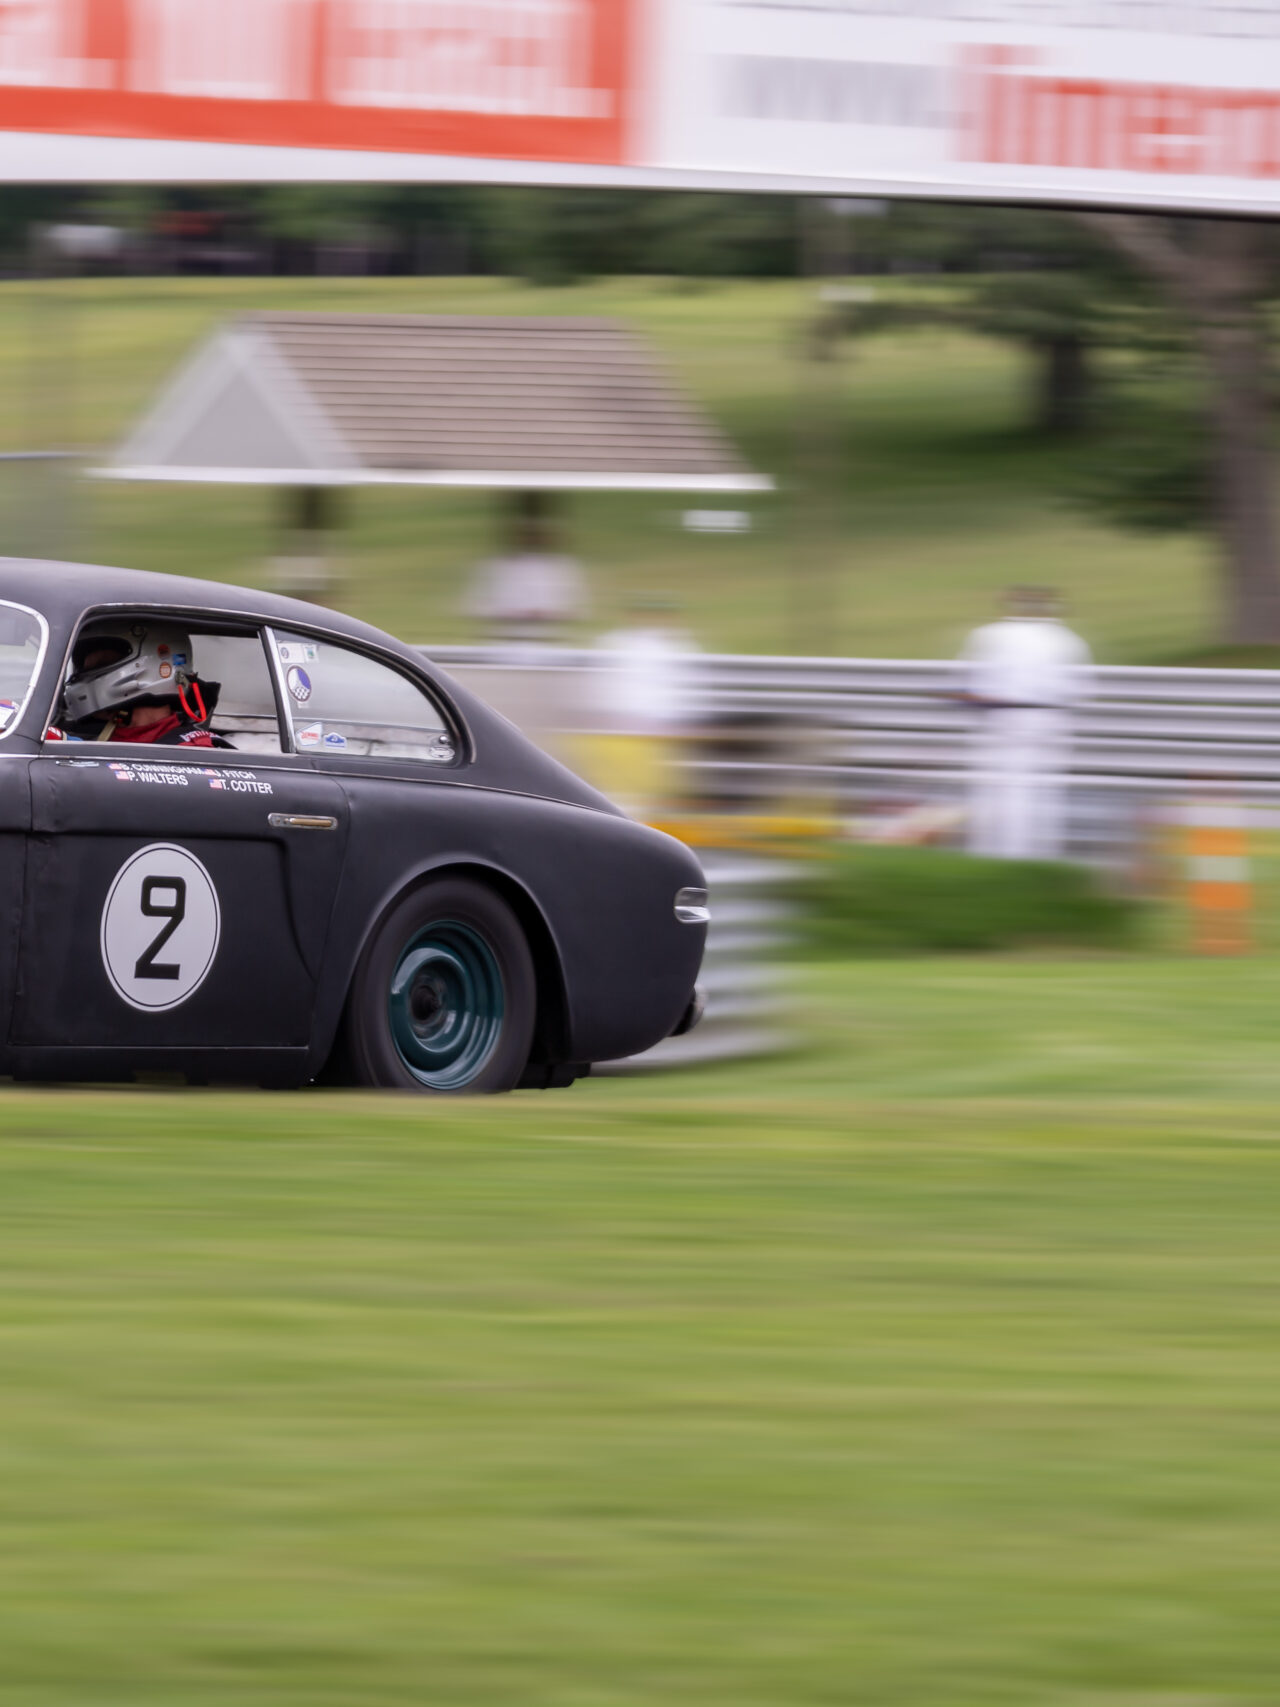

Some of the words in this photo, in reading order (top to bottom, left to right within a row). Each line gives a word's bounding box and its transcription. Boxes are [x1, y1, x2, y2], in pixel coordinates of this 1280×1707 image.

[126, 770, 139, 781] P.
[137, 771, 189, 786] WALTERS
[223, 769, 257, 780] FITCH
[219, 778, 230, 791] T.
[230, 779, 273, 795] COTTER
